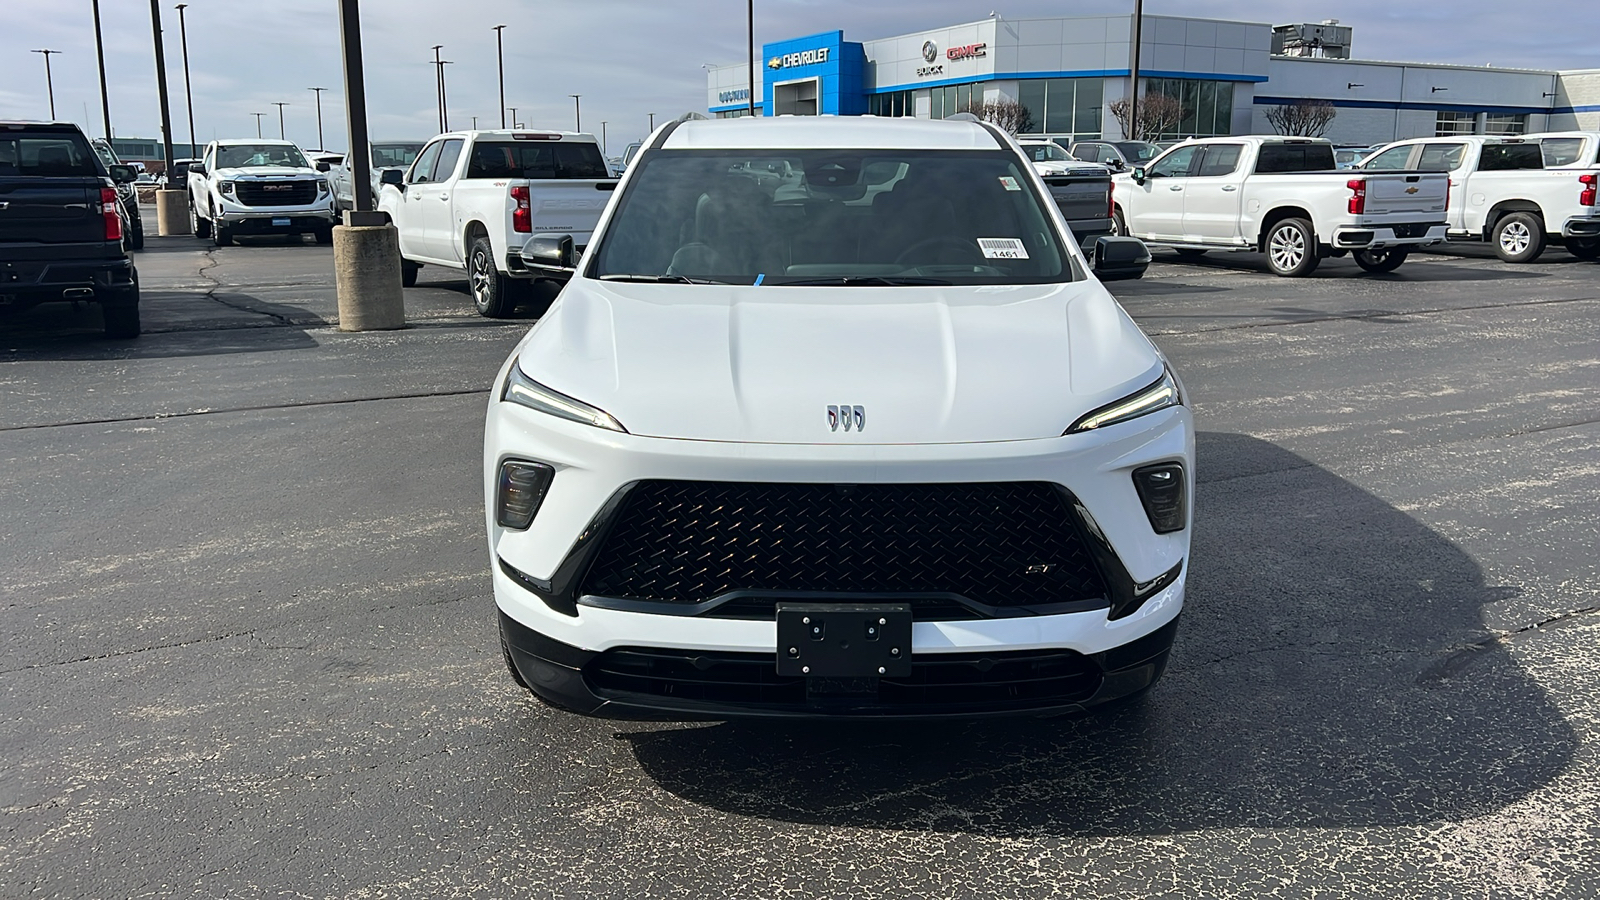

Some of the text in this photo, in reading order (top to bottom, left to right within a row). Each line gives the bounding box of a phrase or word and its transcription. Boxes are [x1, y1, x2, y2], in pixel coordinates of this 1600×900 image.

[783, 47, 829, 67] CHEVROLET
[947, 43, 985, 60] GMC
[916, 65, 943, 77] BUICK
[992, 251, 1019, 259] 1461
